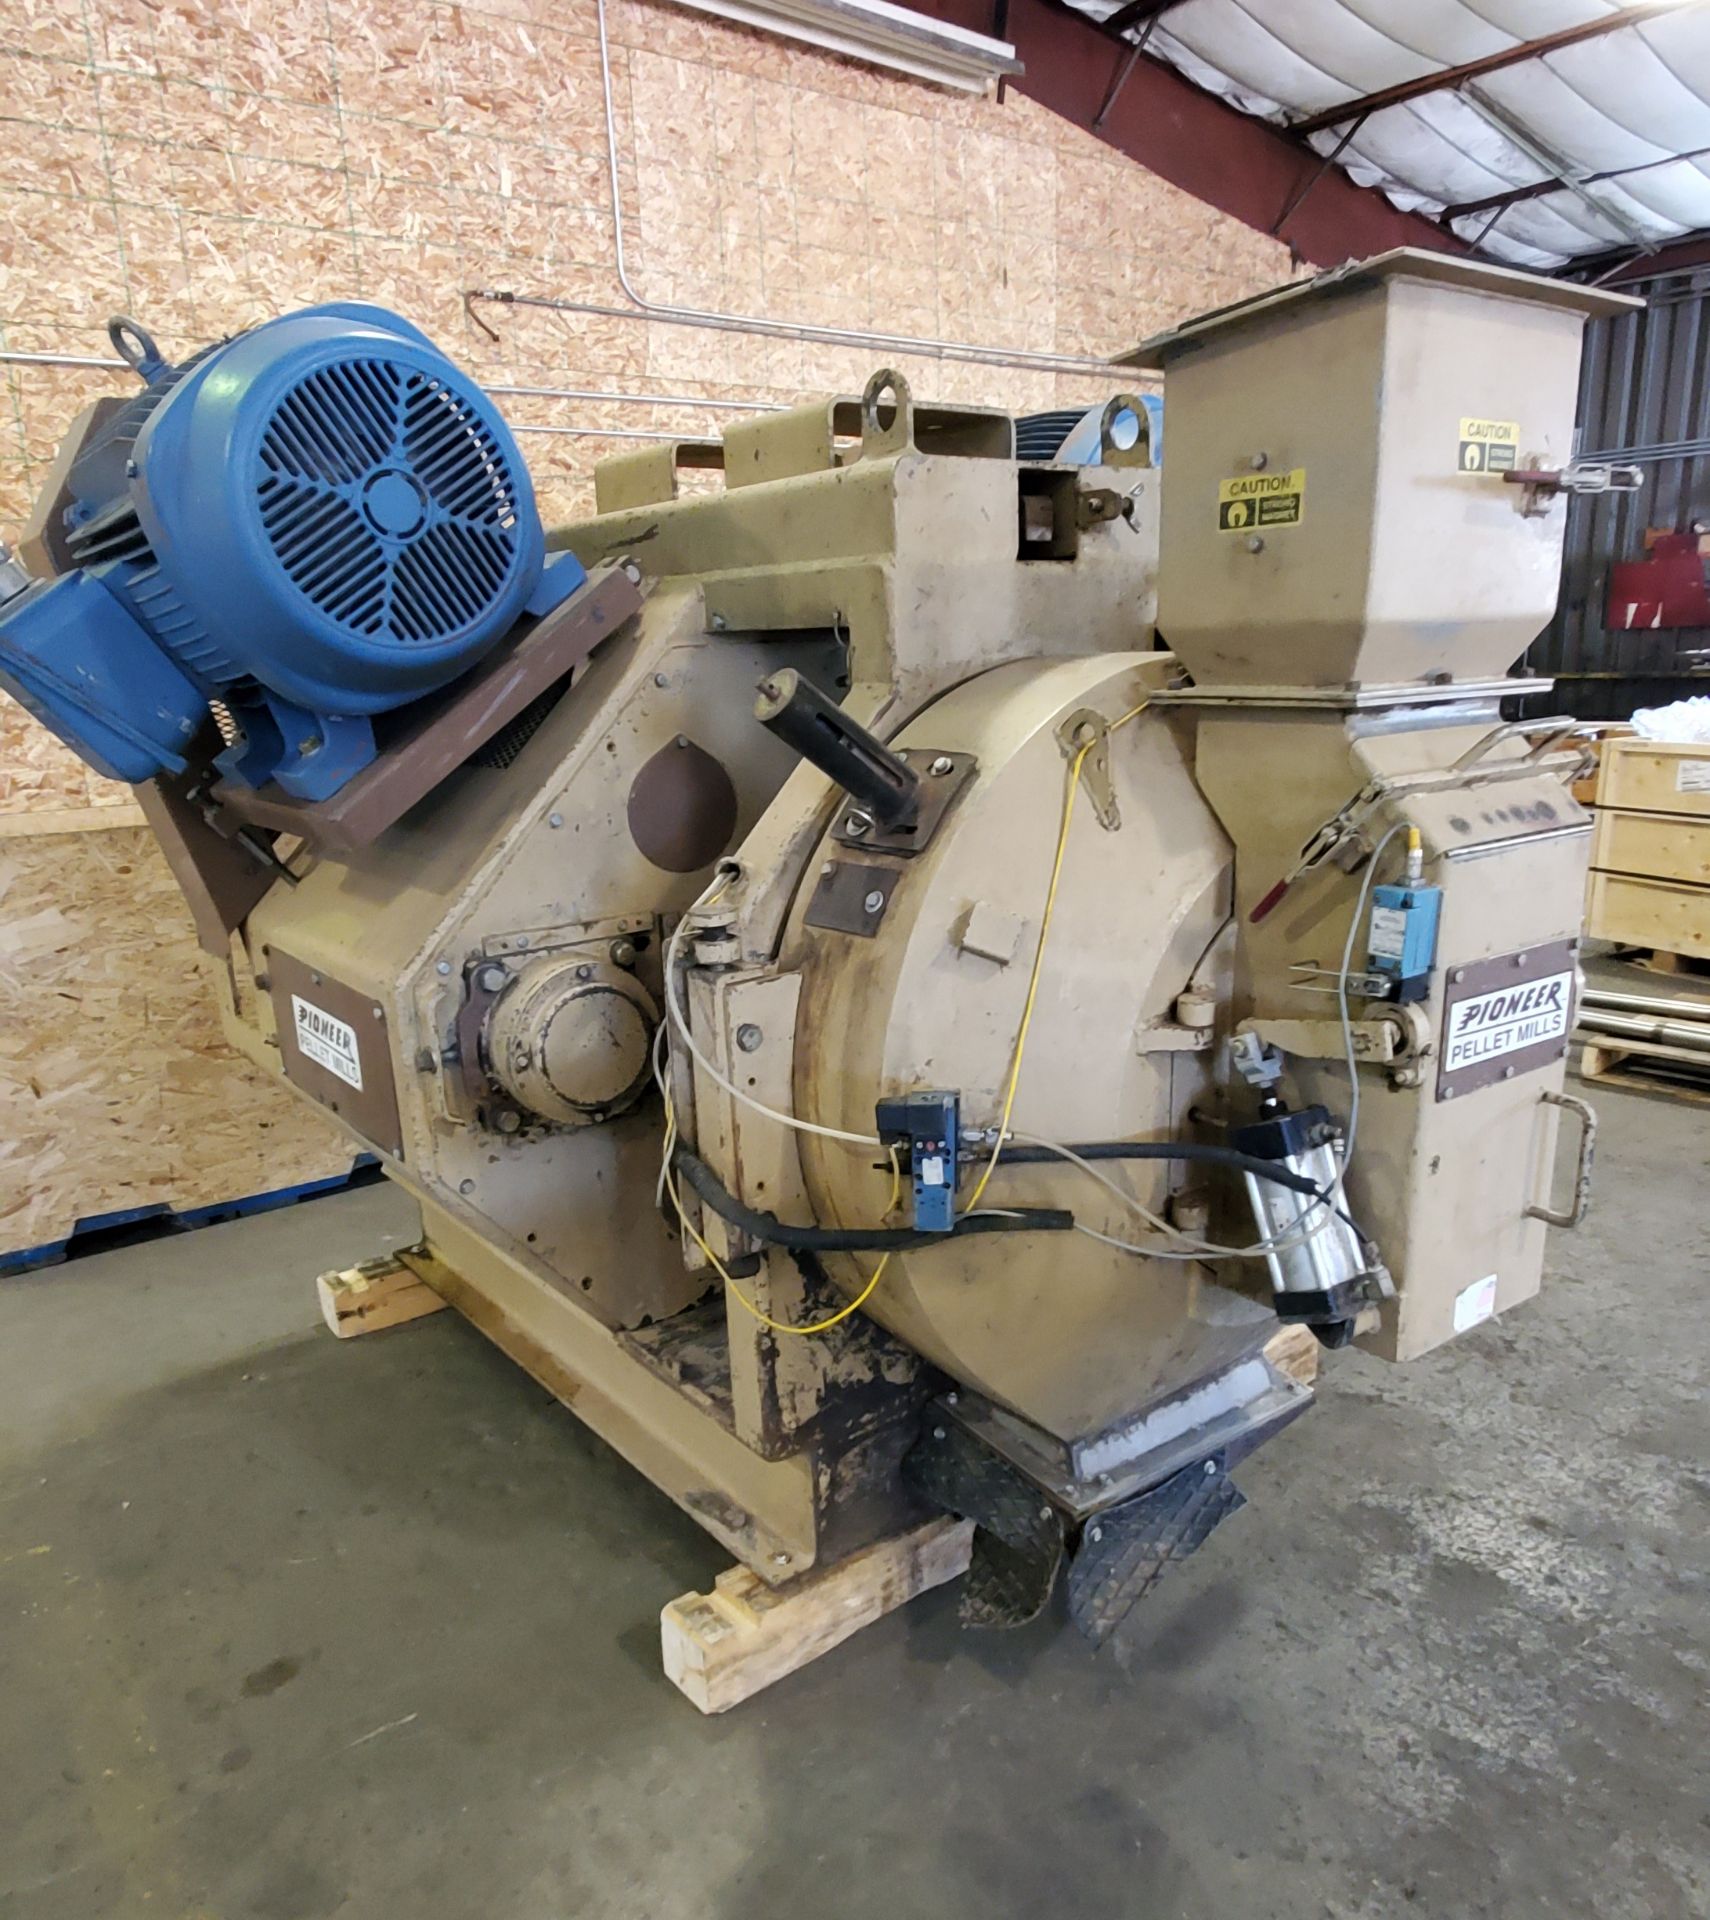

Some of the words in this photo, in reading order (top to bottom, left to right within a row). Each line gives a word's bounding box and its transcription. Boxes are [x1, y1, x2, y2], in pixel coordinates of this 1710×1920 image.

[1467, 423, 1512, 440] CAUTION
[1229, 475, 1292, 497] CAUTION
[1456, 980, 1563, 1032] PIONEER
[298, 1004, 355, 1065] PIONEER
[1451, 1028, 1514, 1064] PELLET
[1516, 1013, 1562, 1042] MILLS
